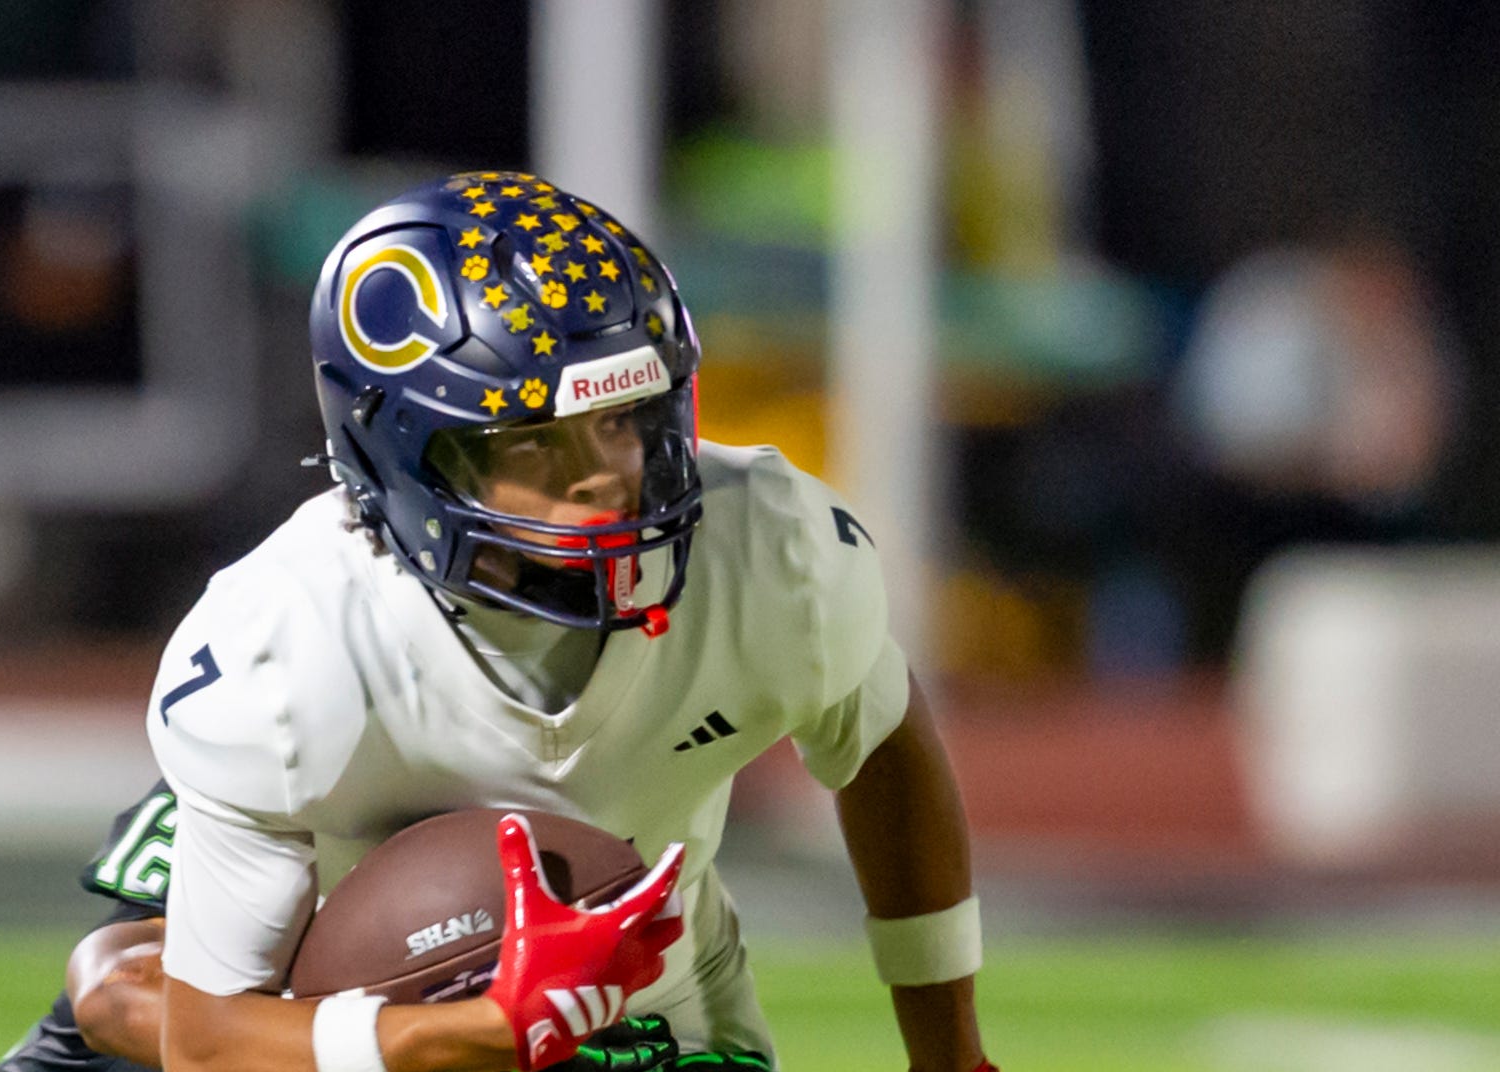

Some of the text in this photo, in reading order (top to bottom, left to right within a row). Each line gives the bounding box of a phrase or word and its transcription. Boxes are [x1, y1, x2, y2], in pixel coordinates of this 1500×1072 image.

[338, 243, 449, 375] C
[572, 360, 661, 401] Riddell
[160, 643, 222, 728] 7
